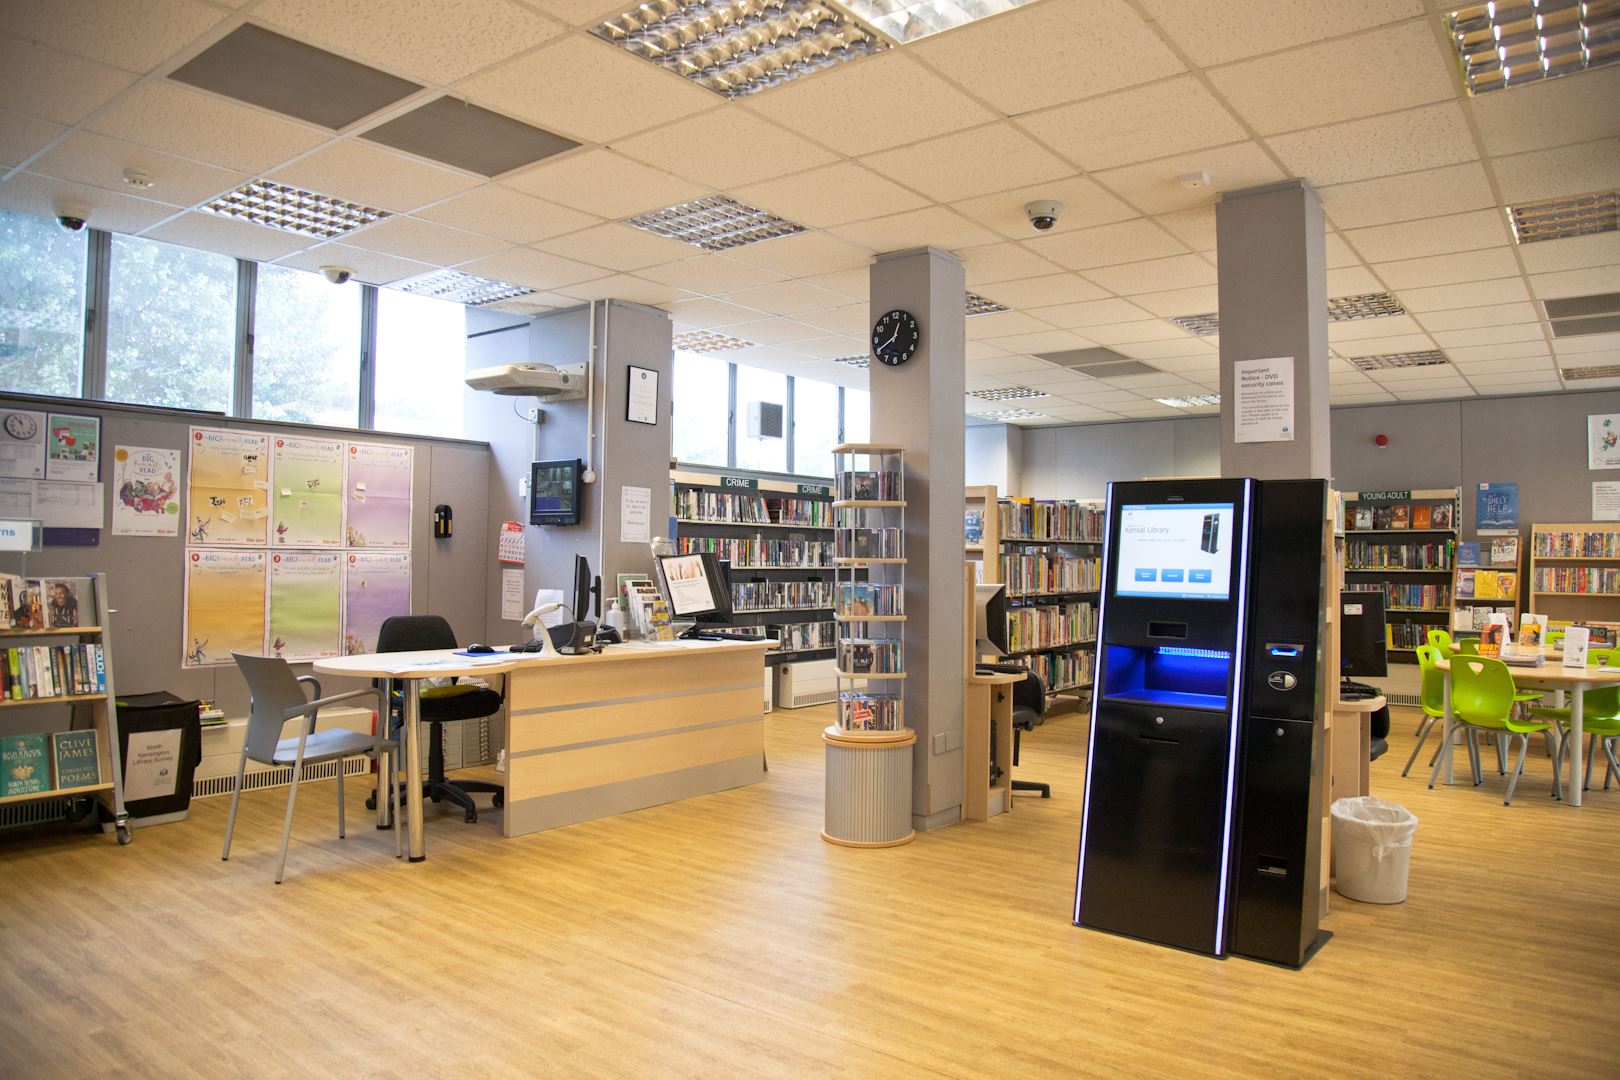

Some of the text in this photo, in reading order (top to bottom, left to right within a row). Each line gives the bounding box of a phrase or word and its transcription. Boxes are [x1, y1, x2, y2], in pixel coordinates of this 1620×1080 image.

[883, 316, 890, 324] 11
[726, 477, 750, 488] CRIME
[802, 485, 822, 494] CRIME
[1363, 492, 1386, 500] YOUNG
[1148, 526, 1169, 534] Library
[60, 739, 91, 750] CLIVE
[60, 748, 94, 760] JAMES
[61, 772, 97, 783] POEMS
